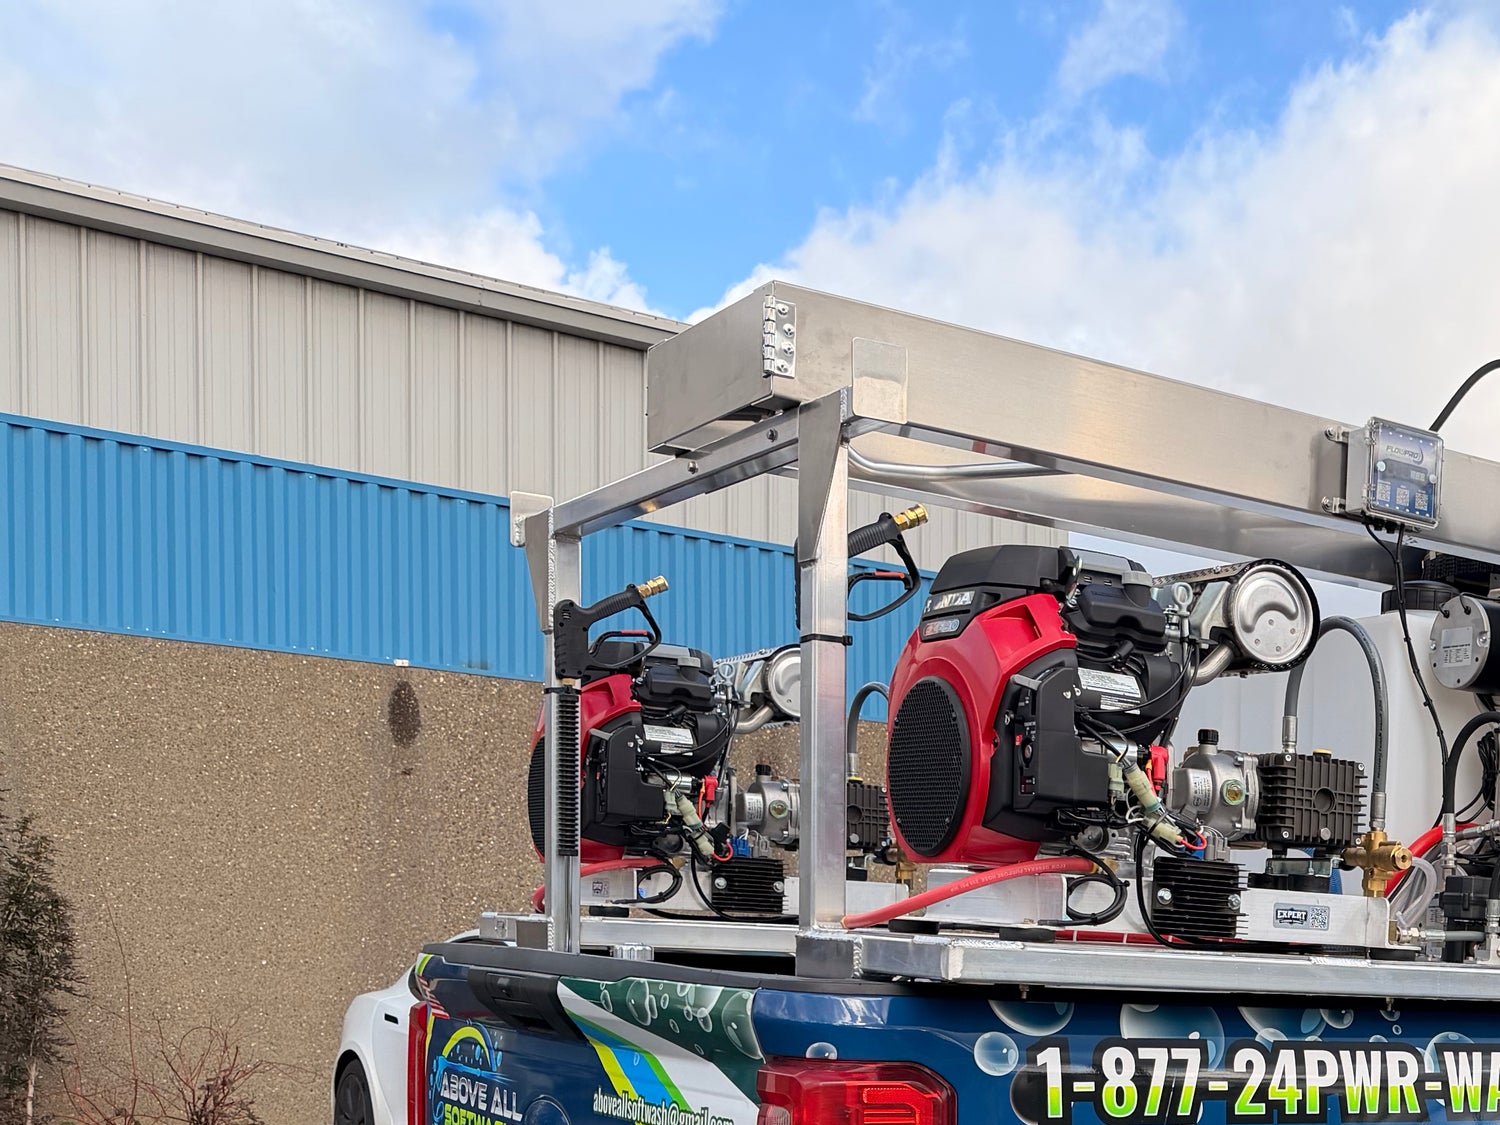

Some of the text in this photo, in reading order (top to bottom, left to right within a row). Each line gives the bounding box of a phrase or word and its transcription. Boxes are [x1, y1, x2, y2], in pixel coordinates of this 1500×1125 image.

[1277, 910, 1306, 920] EXPERT
[440, 1071, 523, 1122] ABOVE ALL
